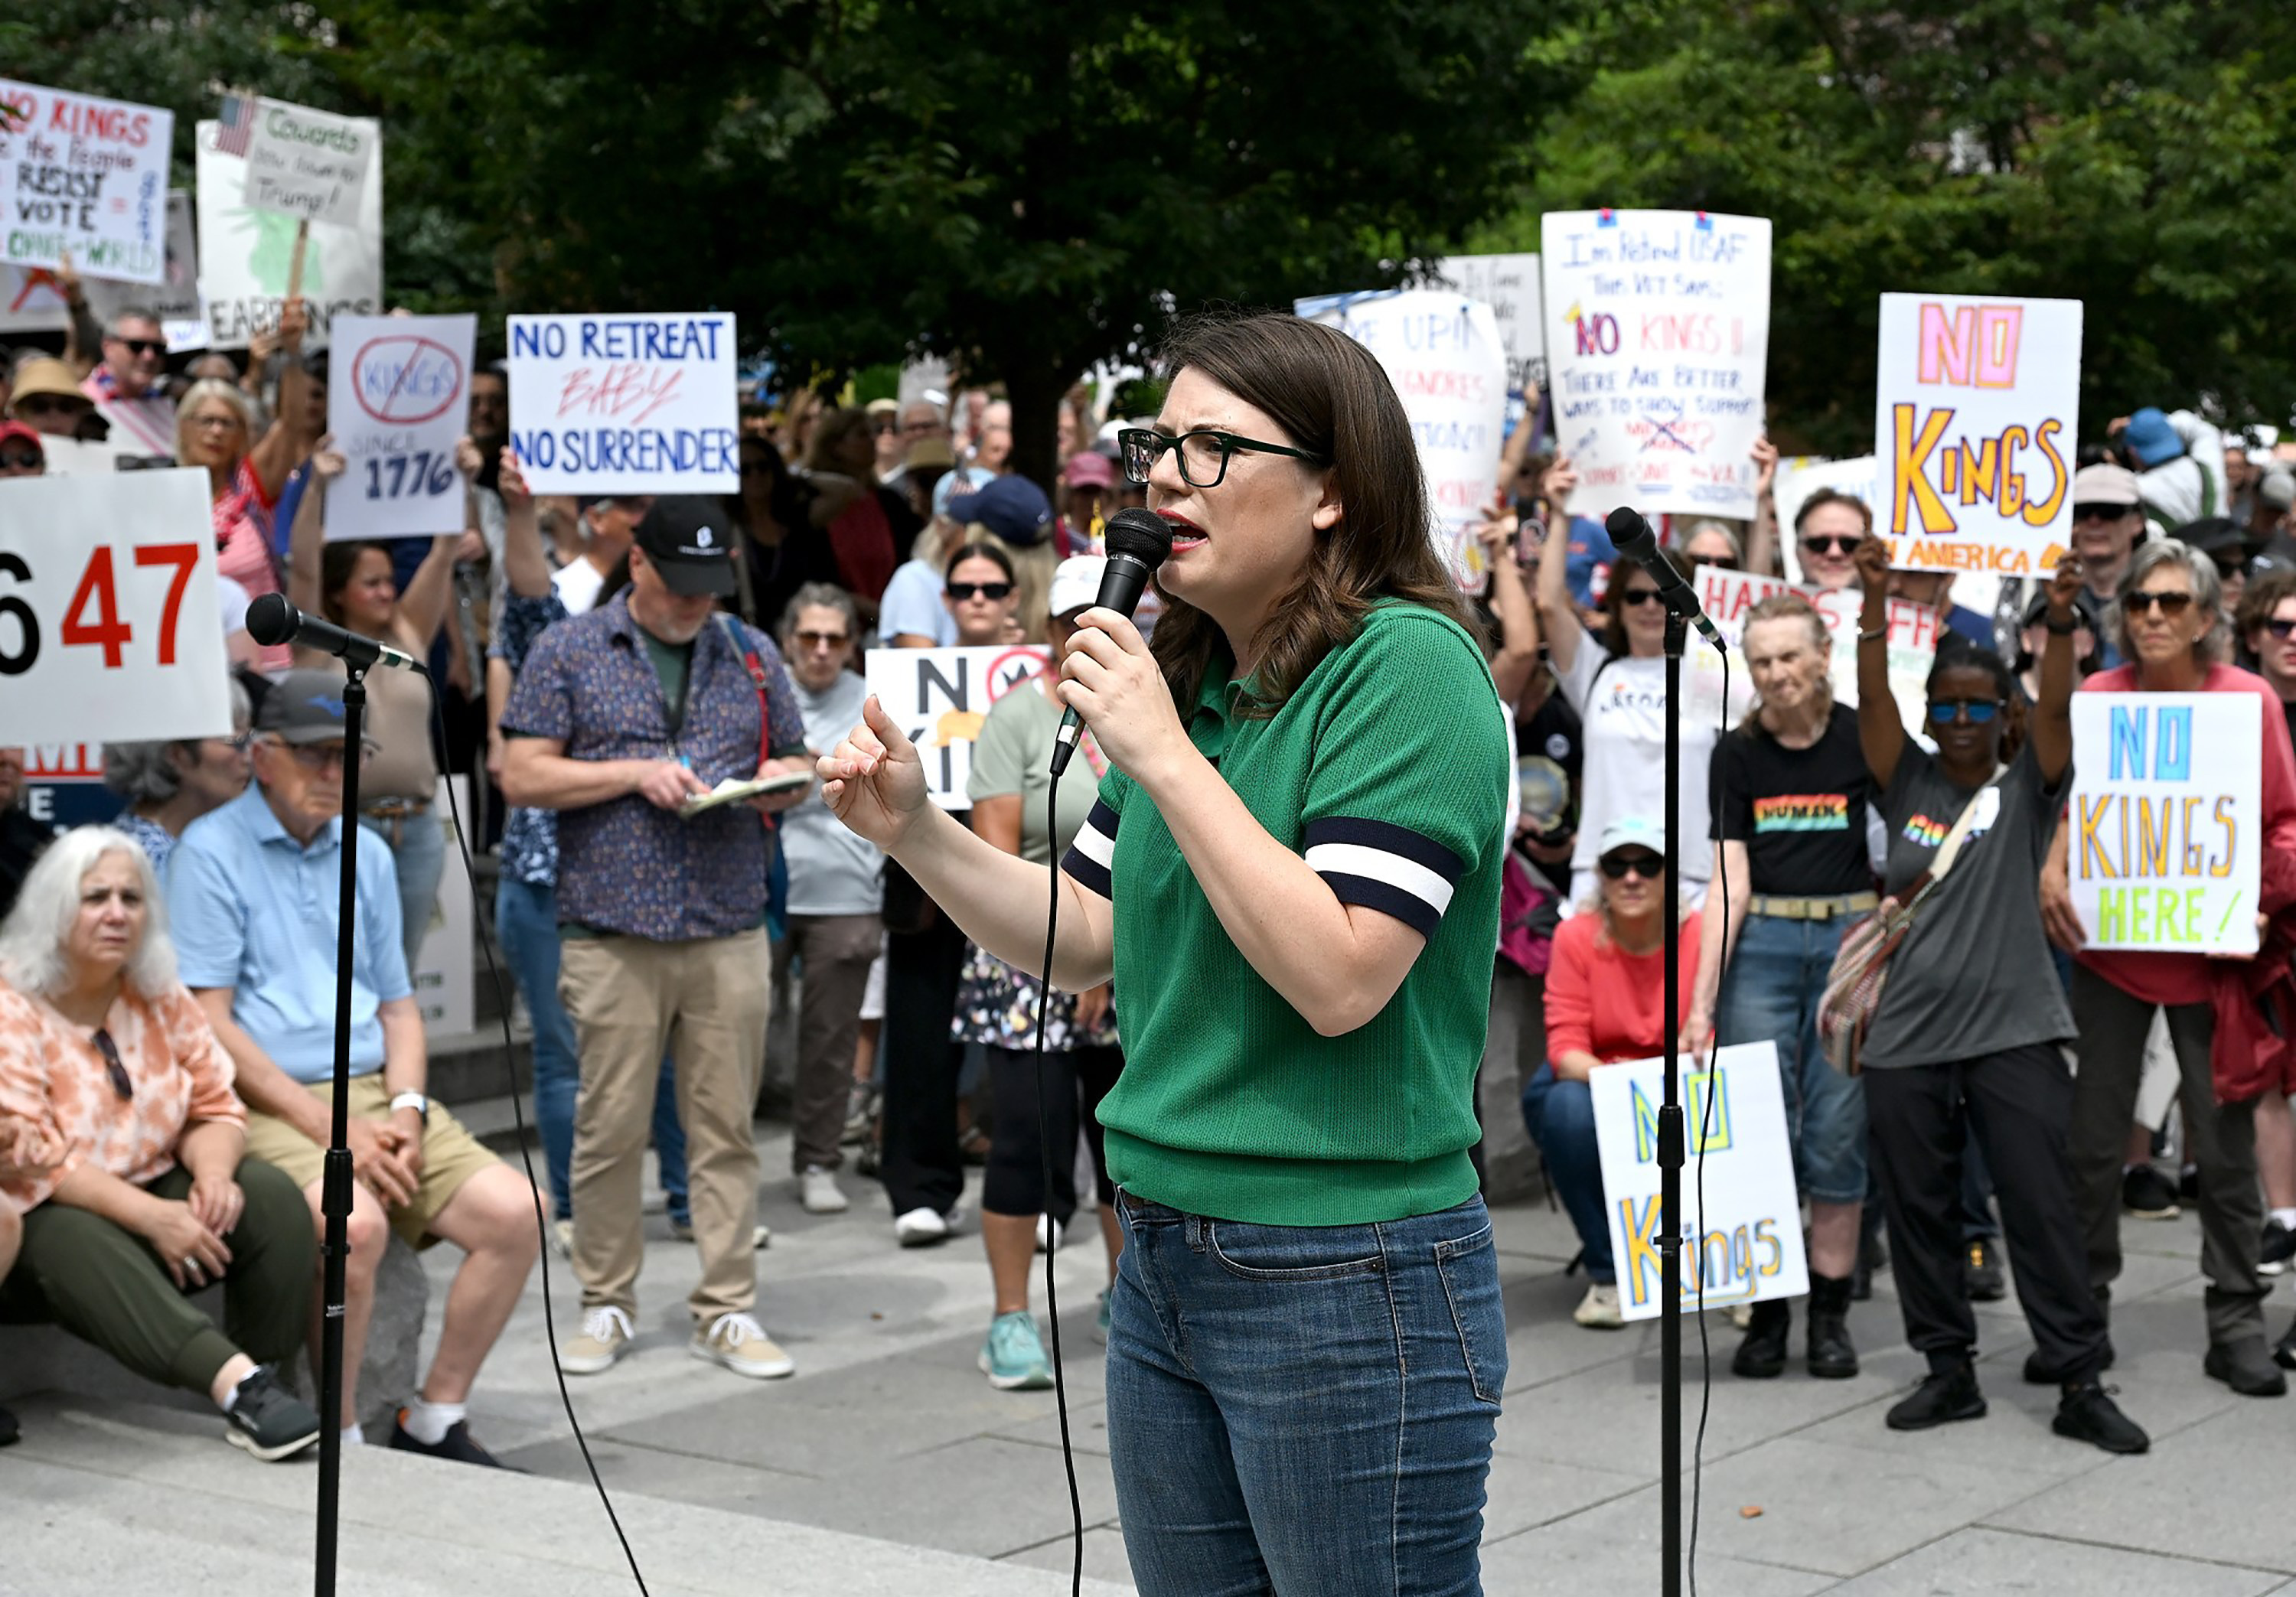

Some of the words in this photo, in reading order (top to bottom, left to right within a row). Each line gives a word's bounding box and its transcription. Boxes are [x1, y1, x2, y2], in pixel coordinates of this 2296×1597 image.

[49, 97, 152, 148] KINGS
[69, 134, 135, 173] People
[17, 160, 106, 197] RESIST
[17, 197, 96, 231] VOTE
[1689, 230, 1748, 263] USAF
[514, 321, 565, 359] NO
[582, 321, 723, 360] RETREAT
[1574, 311, 1620, 357] NO
[1639, 312, 1721, 354] KINGS
[1918, 302, 2024, 389] NO
[364, 359, 454, 399] KINGS
[556, 367, 684, 425] BABY
[1674, 363, 1743, 390] BETTER
[351, 432, 416, 458] SINCE
[511, 431, 555, 470] NO
[563, 429, 740, 476] SURRENDER
[367, 449, 454, 500] 1776
[1906, 539, 2030, 573] AMERICA
[61, 543, 199, 669] 47
[2109, 705, 2193, 781] NO
[1763, 805, 1835, 820] HUMAN
[2078, 793, 2236, 881] KINGS
[1618, 1191, 1782, 1309] Kings
